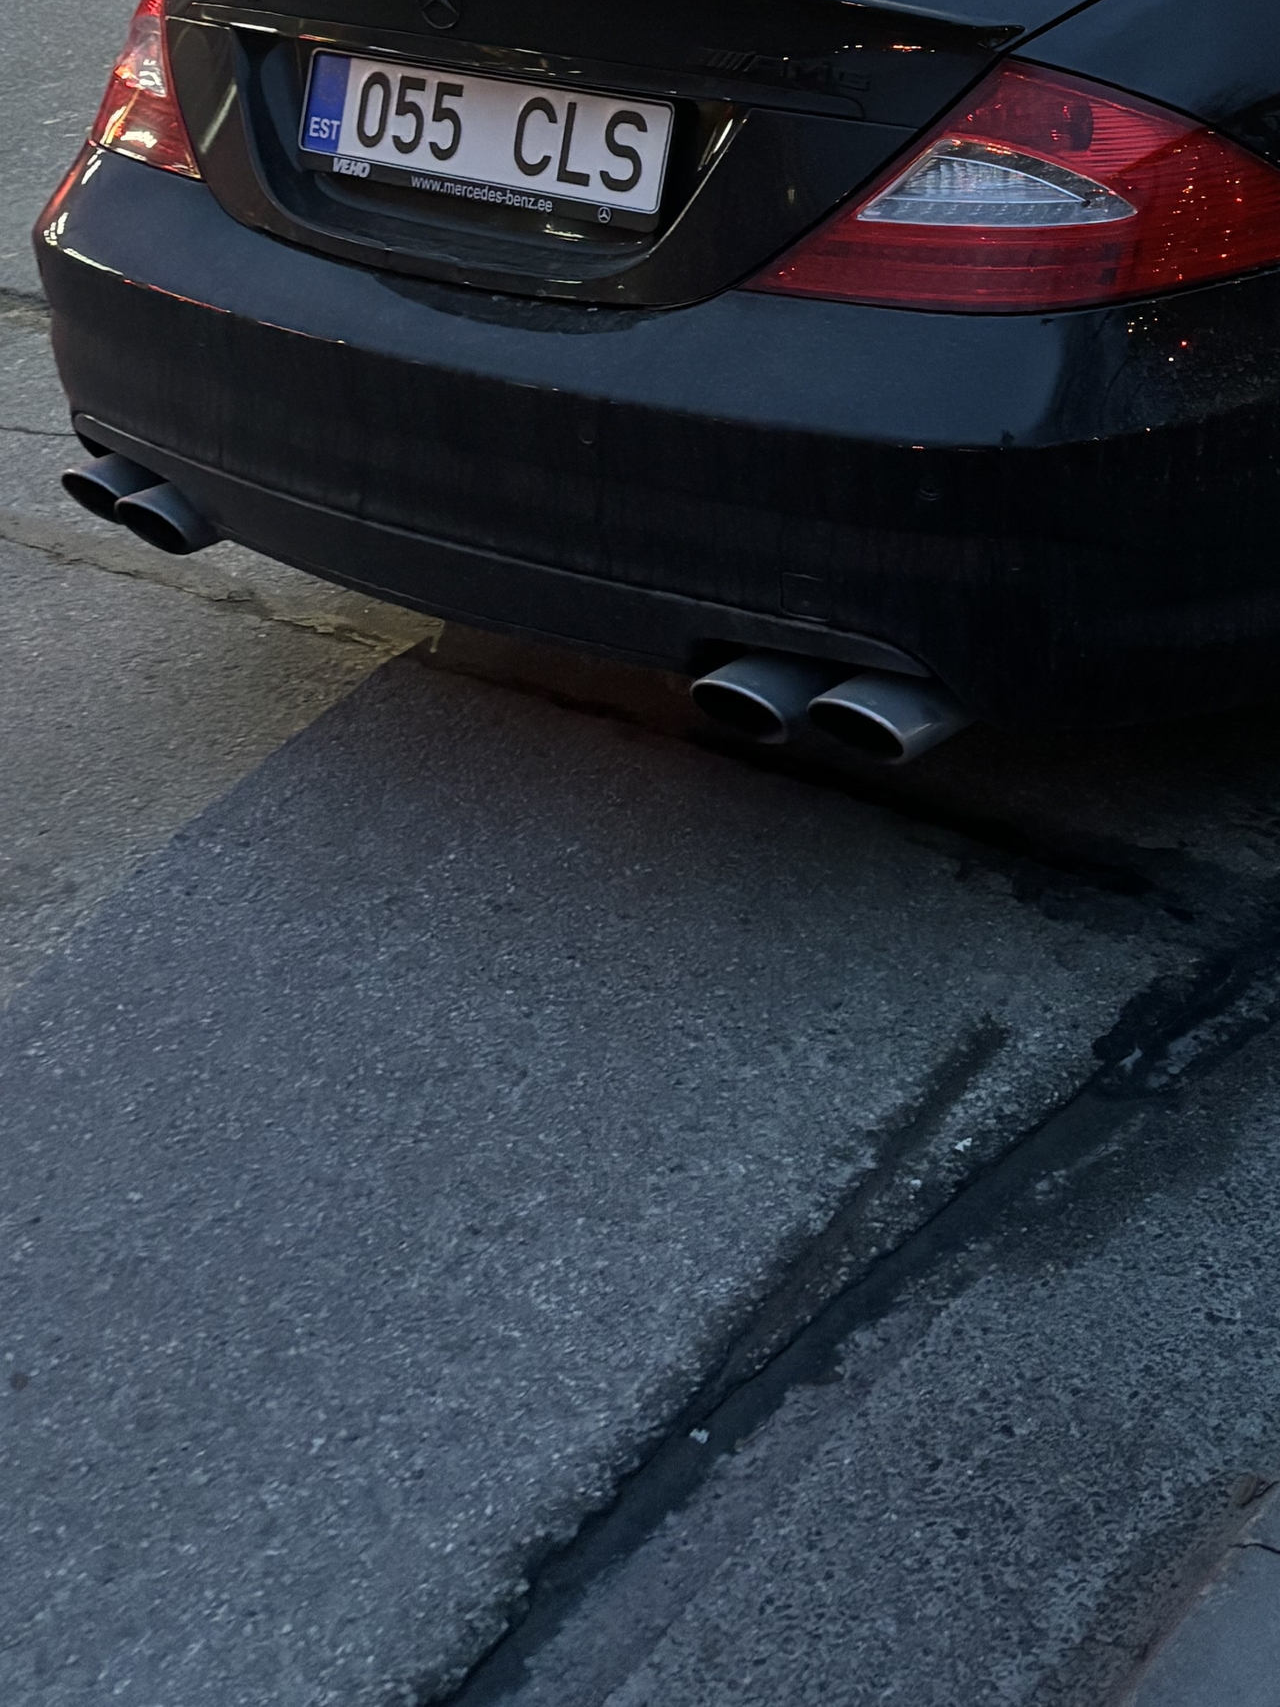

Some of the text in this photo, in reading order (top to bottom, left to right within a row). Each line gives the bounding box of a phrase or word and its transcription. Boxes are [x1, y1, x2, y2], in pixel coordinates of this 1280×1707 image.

[309, 116, 341, 140] EST
[357, 71, 648, 192] 055 CLS
[332, 158, 371, 178] VEHO
[411, 175, 553, 213] www.mercedes-benz.ee
